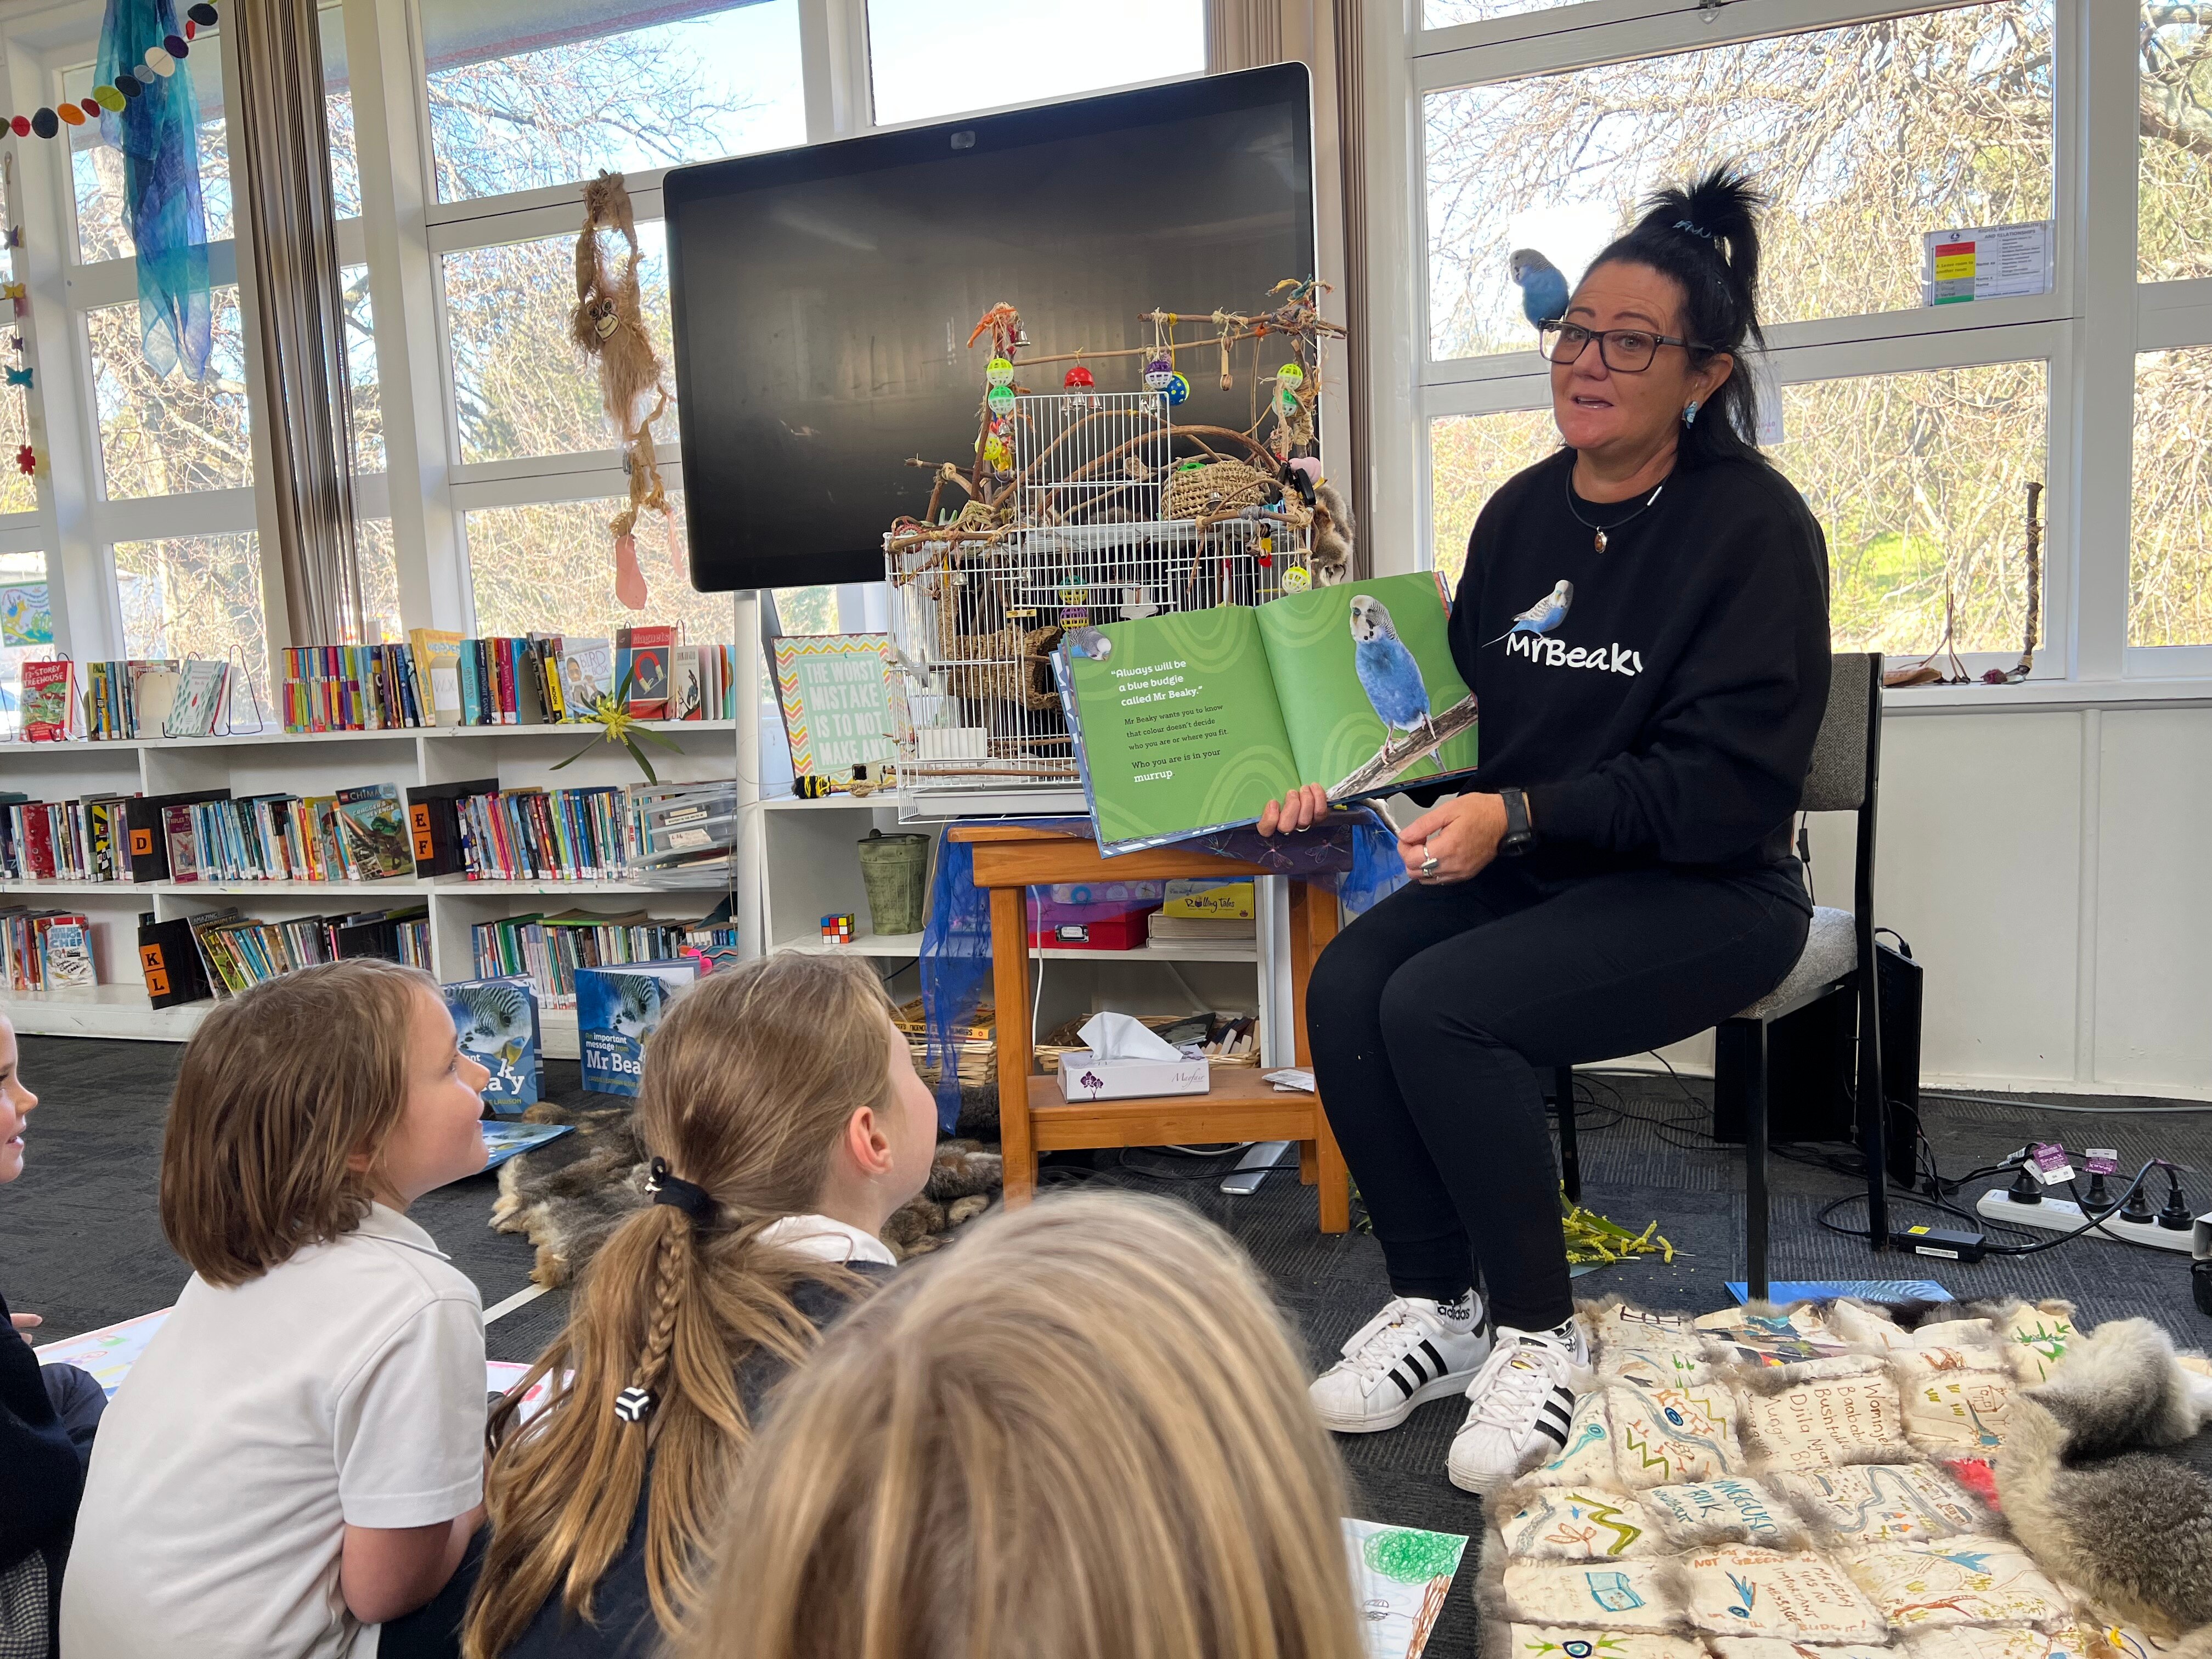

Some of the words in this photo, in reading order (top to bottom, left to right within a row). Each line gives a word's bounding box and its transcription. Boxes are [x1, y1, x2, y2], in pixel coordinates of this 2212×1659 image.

[579, 650, 606, 668] BIRD
[1154, 661, 1173, 672] will
[1173, 660, 1187, 669] be
[591, 664, 609, 676] BOX
[804, 662, 829, 684] THE
[830, 660, 875, 683] WORST
[1127, 681, 1149, 691] blue
[1150, 675, 1184, 687] budgie
[809, 684, 879, 711] MISTAKE
[1121, 694, 1152, 706] called
[1153, 692, 1166, 702] Mr
[1136, 715, 1158, 724] Beaky
[1181, 709, 1194, 718] you
[1193, 718, 1216, 727] decide
[815, 714, 830, 738] IS
[832, 714, 852, 737] TO
[854, 711, 883, 736] NOT
[1144, 741, 1158, 749] you
[1181, 733, 1203, 742] where
[1204, 731, 1217, 740] you
[819, 740, 859, 766] MAKE
[861, 738, 889, 763] ANY
[1131, 761, 1150, 769] Who
[1152, 759, 1167, 768] you
[1202, 749, 1221, 759] your
[415, 813, 427, 828] E
[136, 837, 147, 850] D
[419, 840, 428, 854] F
[1218, 898, 1235, 907] Tales
[193, 913, 218, 923] AMAZING
[49, 939, 82, 949] CHEF
[145, 952, 160, 967] K
[152, 978, 165, 991] L
[593, 1032, 627, 1045] important
[586, 1041, 615, 1052] message
[586, 1049, 609, 1070] Mr
[1171, 1068, 1205, 1090] Mayfair
[1789, 1394, 1813, 1434] Djila
[1694, 1558, 1719, 1568] NOT
